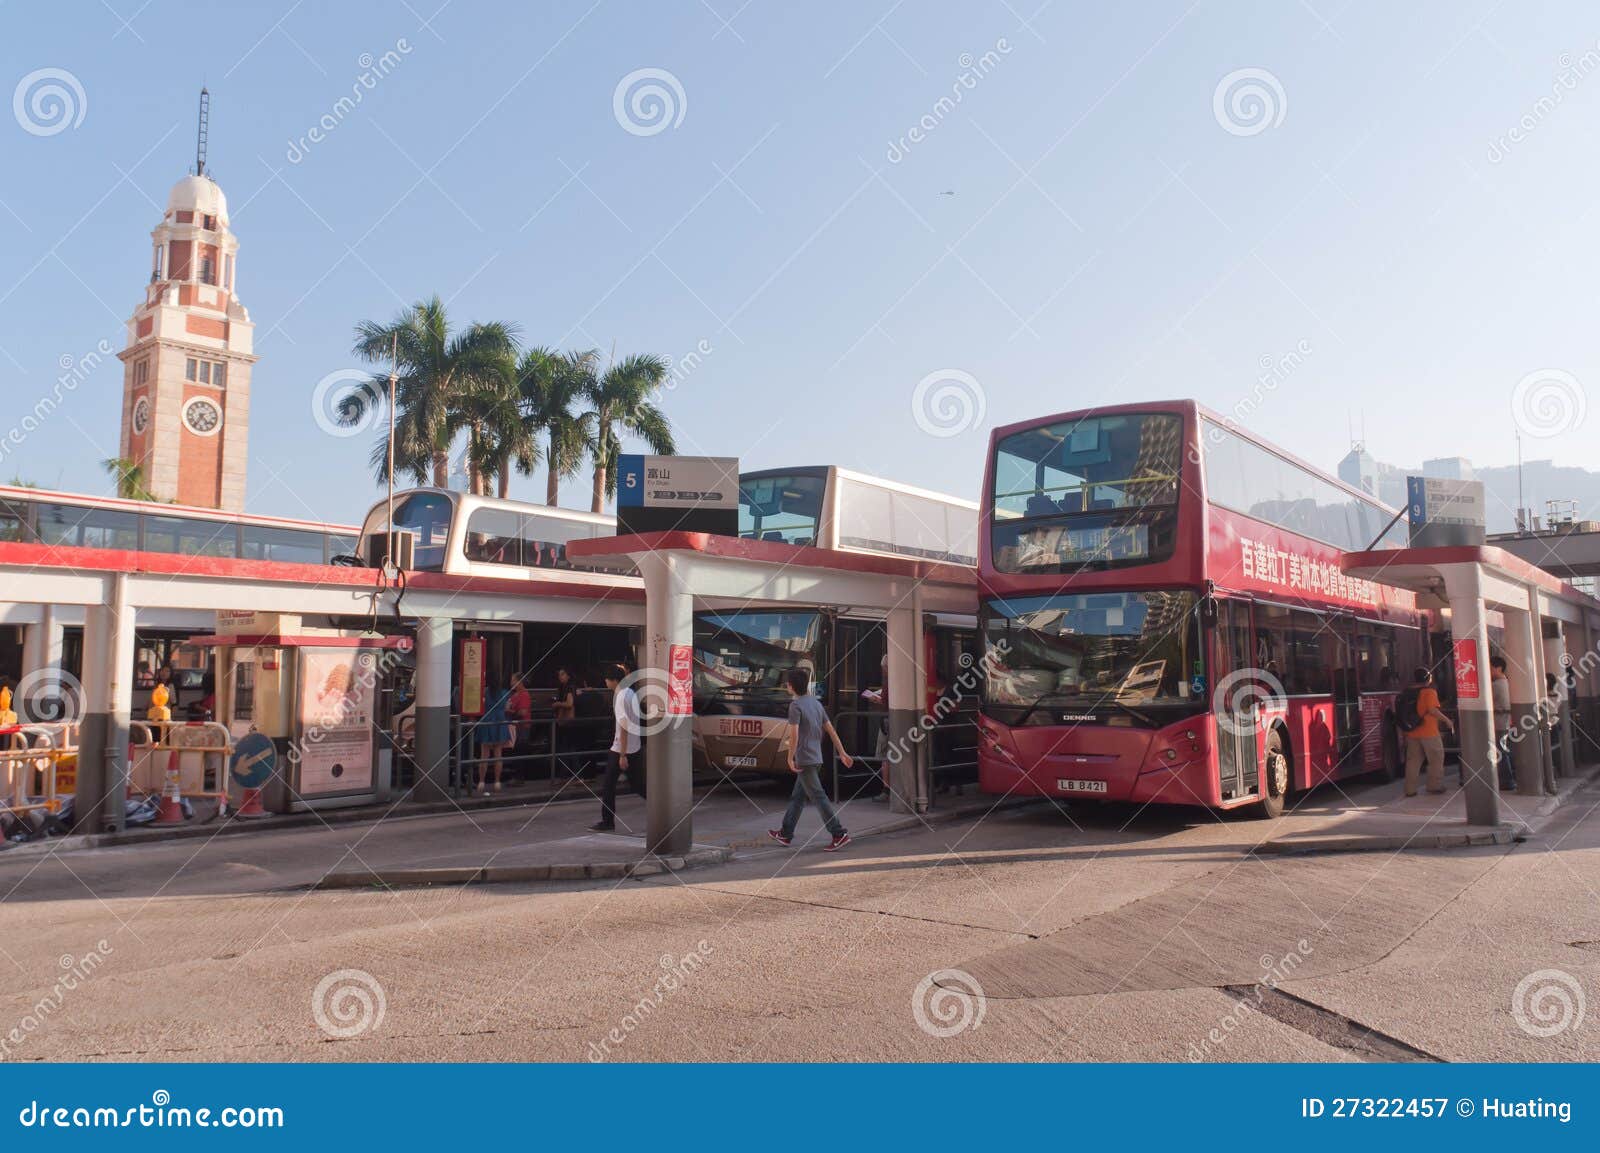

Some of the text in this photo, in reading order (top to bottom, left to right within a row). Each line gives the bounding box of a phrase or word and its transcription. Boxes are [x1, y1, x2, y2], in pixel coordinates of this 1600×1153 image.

[625, 472, 637, 488] 5
[1412, 482, 1419, 495] 1
[1413, 504, 1421, 517] 9
[732, 719, 763, 737] KMB
[1061, 781, 1105, 792] LB 8421
